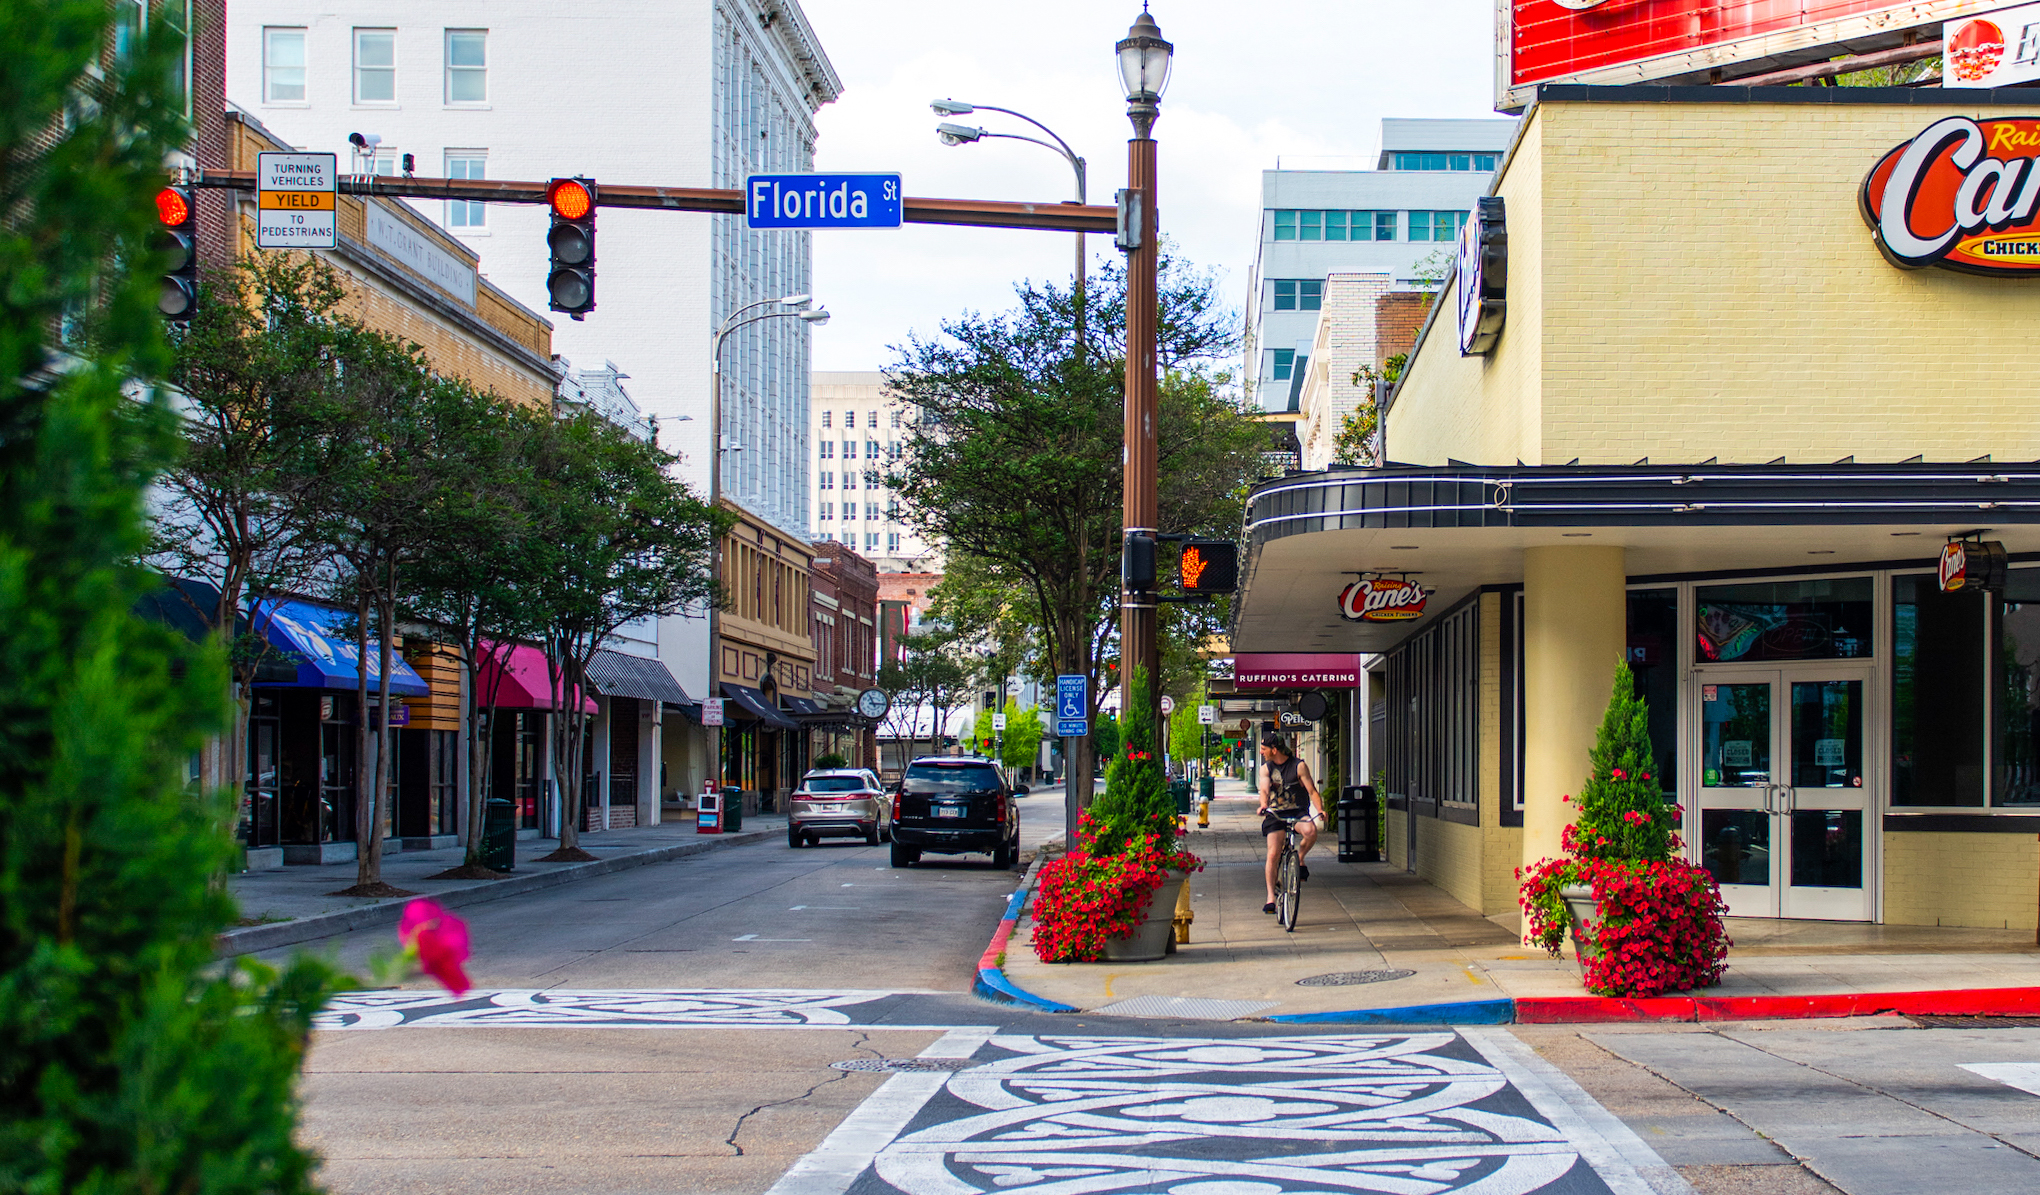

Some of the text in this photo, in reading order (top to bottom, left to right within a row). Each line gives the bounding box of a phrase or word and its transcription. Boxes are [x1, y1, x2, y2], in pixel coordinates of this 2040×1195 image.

[1989, 124, 2040, 151] Rai
[274, 164, 321, 174] TURNING
[271, 176, 324, 186] VEHICLES
[276, 194, 319, 207] YIELD
[752, 180, 897, 218] Florida St
[290, 215, 304, 224] TO
[262, 227, 332, 237] PEDESTRIANS
[1983, 239, 2040, 255] CHICK
[428, 251, 462, 288] BUILDING
[1373, 581, 1402, 591] Raising
[1344, 580, 1426, 619] Cane's
[1239, 674, 1355, 683] RUFFINO'S CATERING
